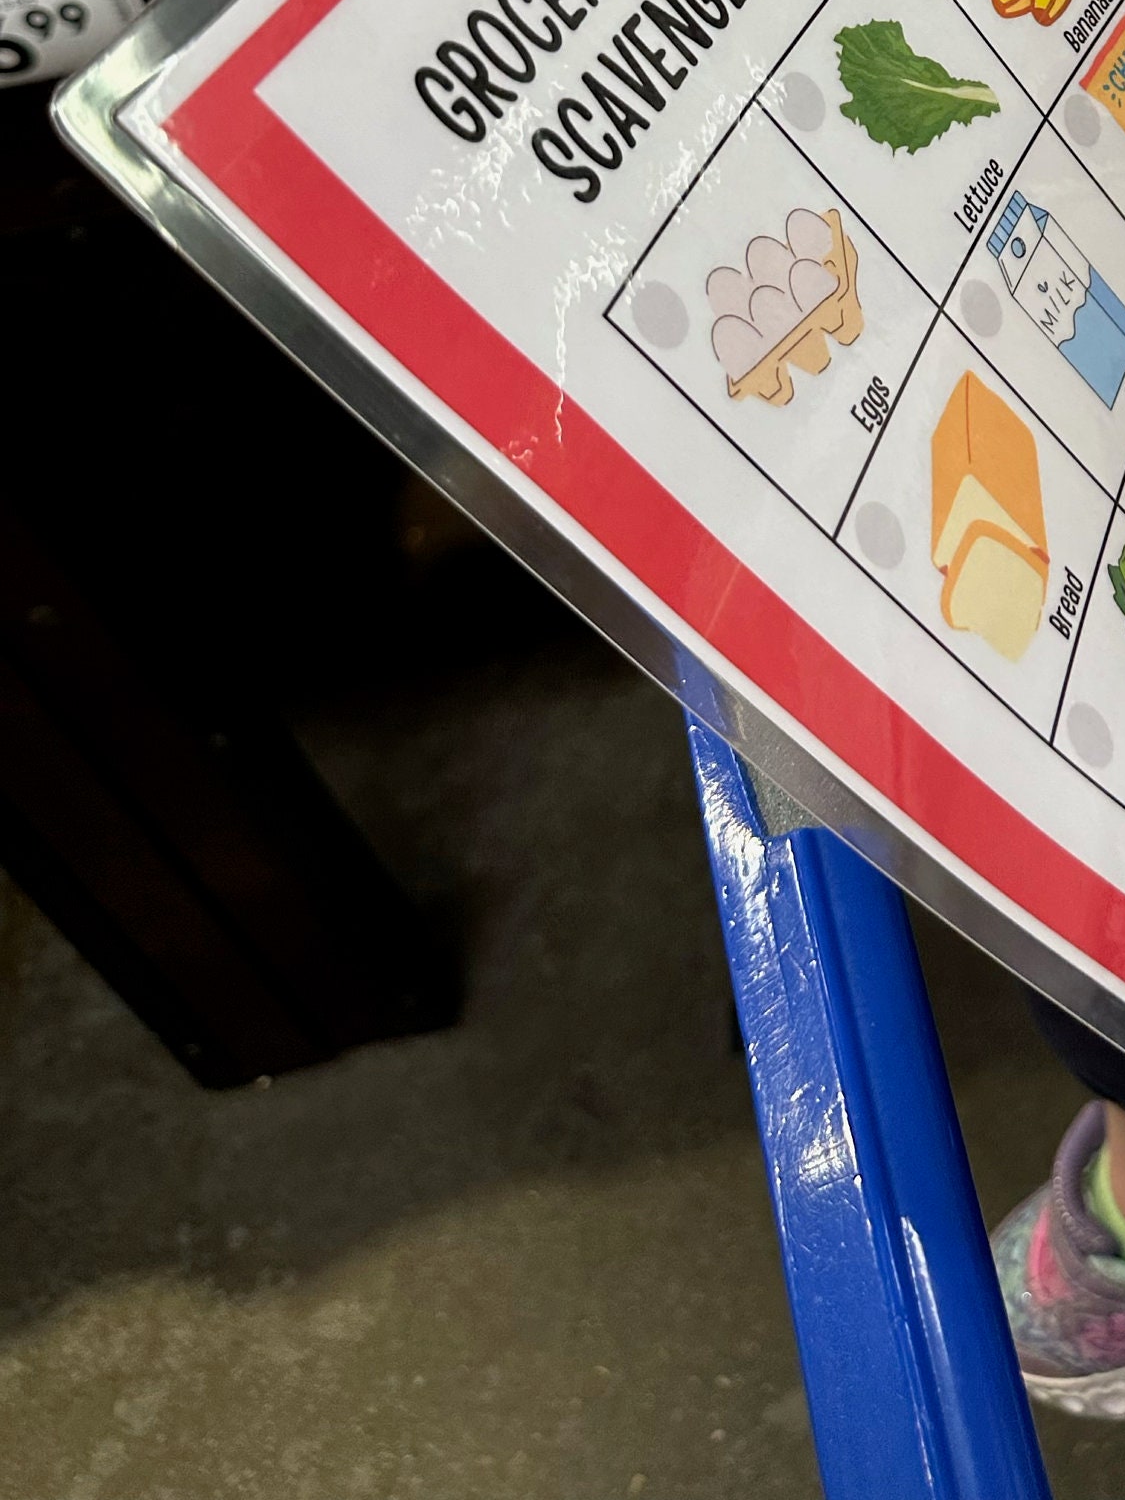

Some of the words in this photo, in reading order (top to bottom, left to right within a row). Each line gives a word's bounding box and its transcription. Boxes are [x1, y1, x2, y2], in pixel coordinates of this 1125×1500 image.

[953, 157, 1004, 234] Lettuce
[1039, 269, 1076, 335] MILK
[849, 375, 891, 434] Eggs
[1050, 567, 1084, 641] Bread
